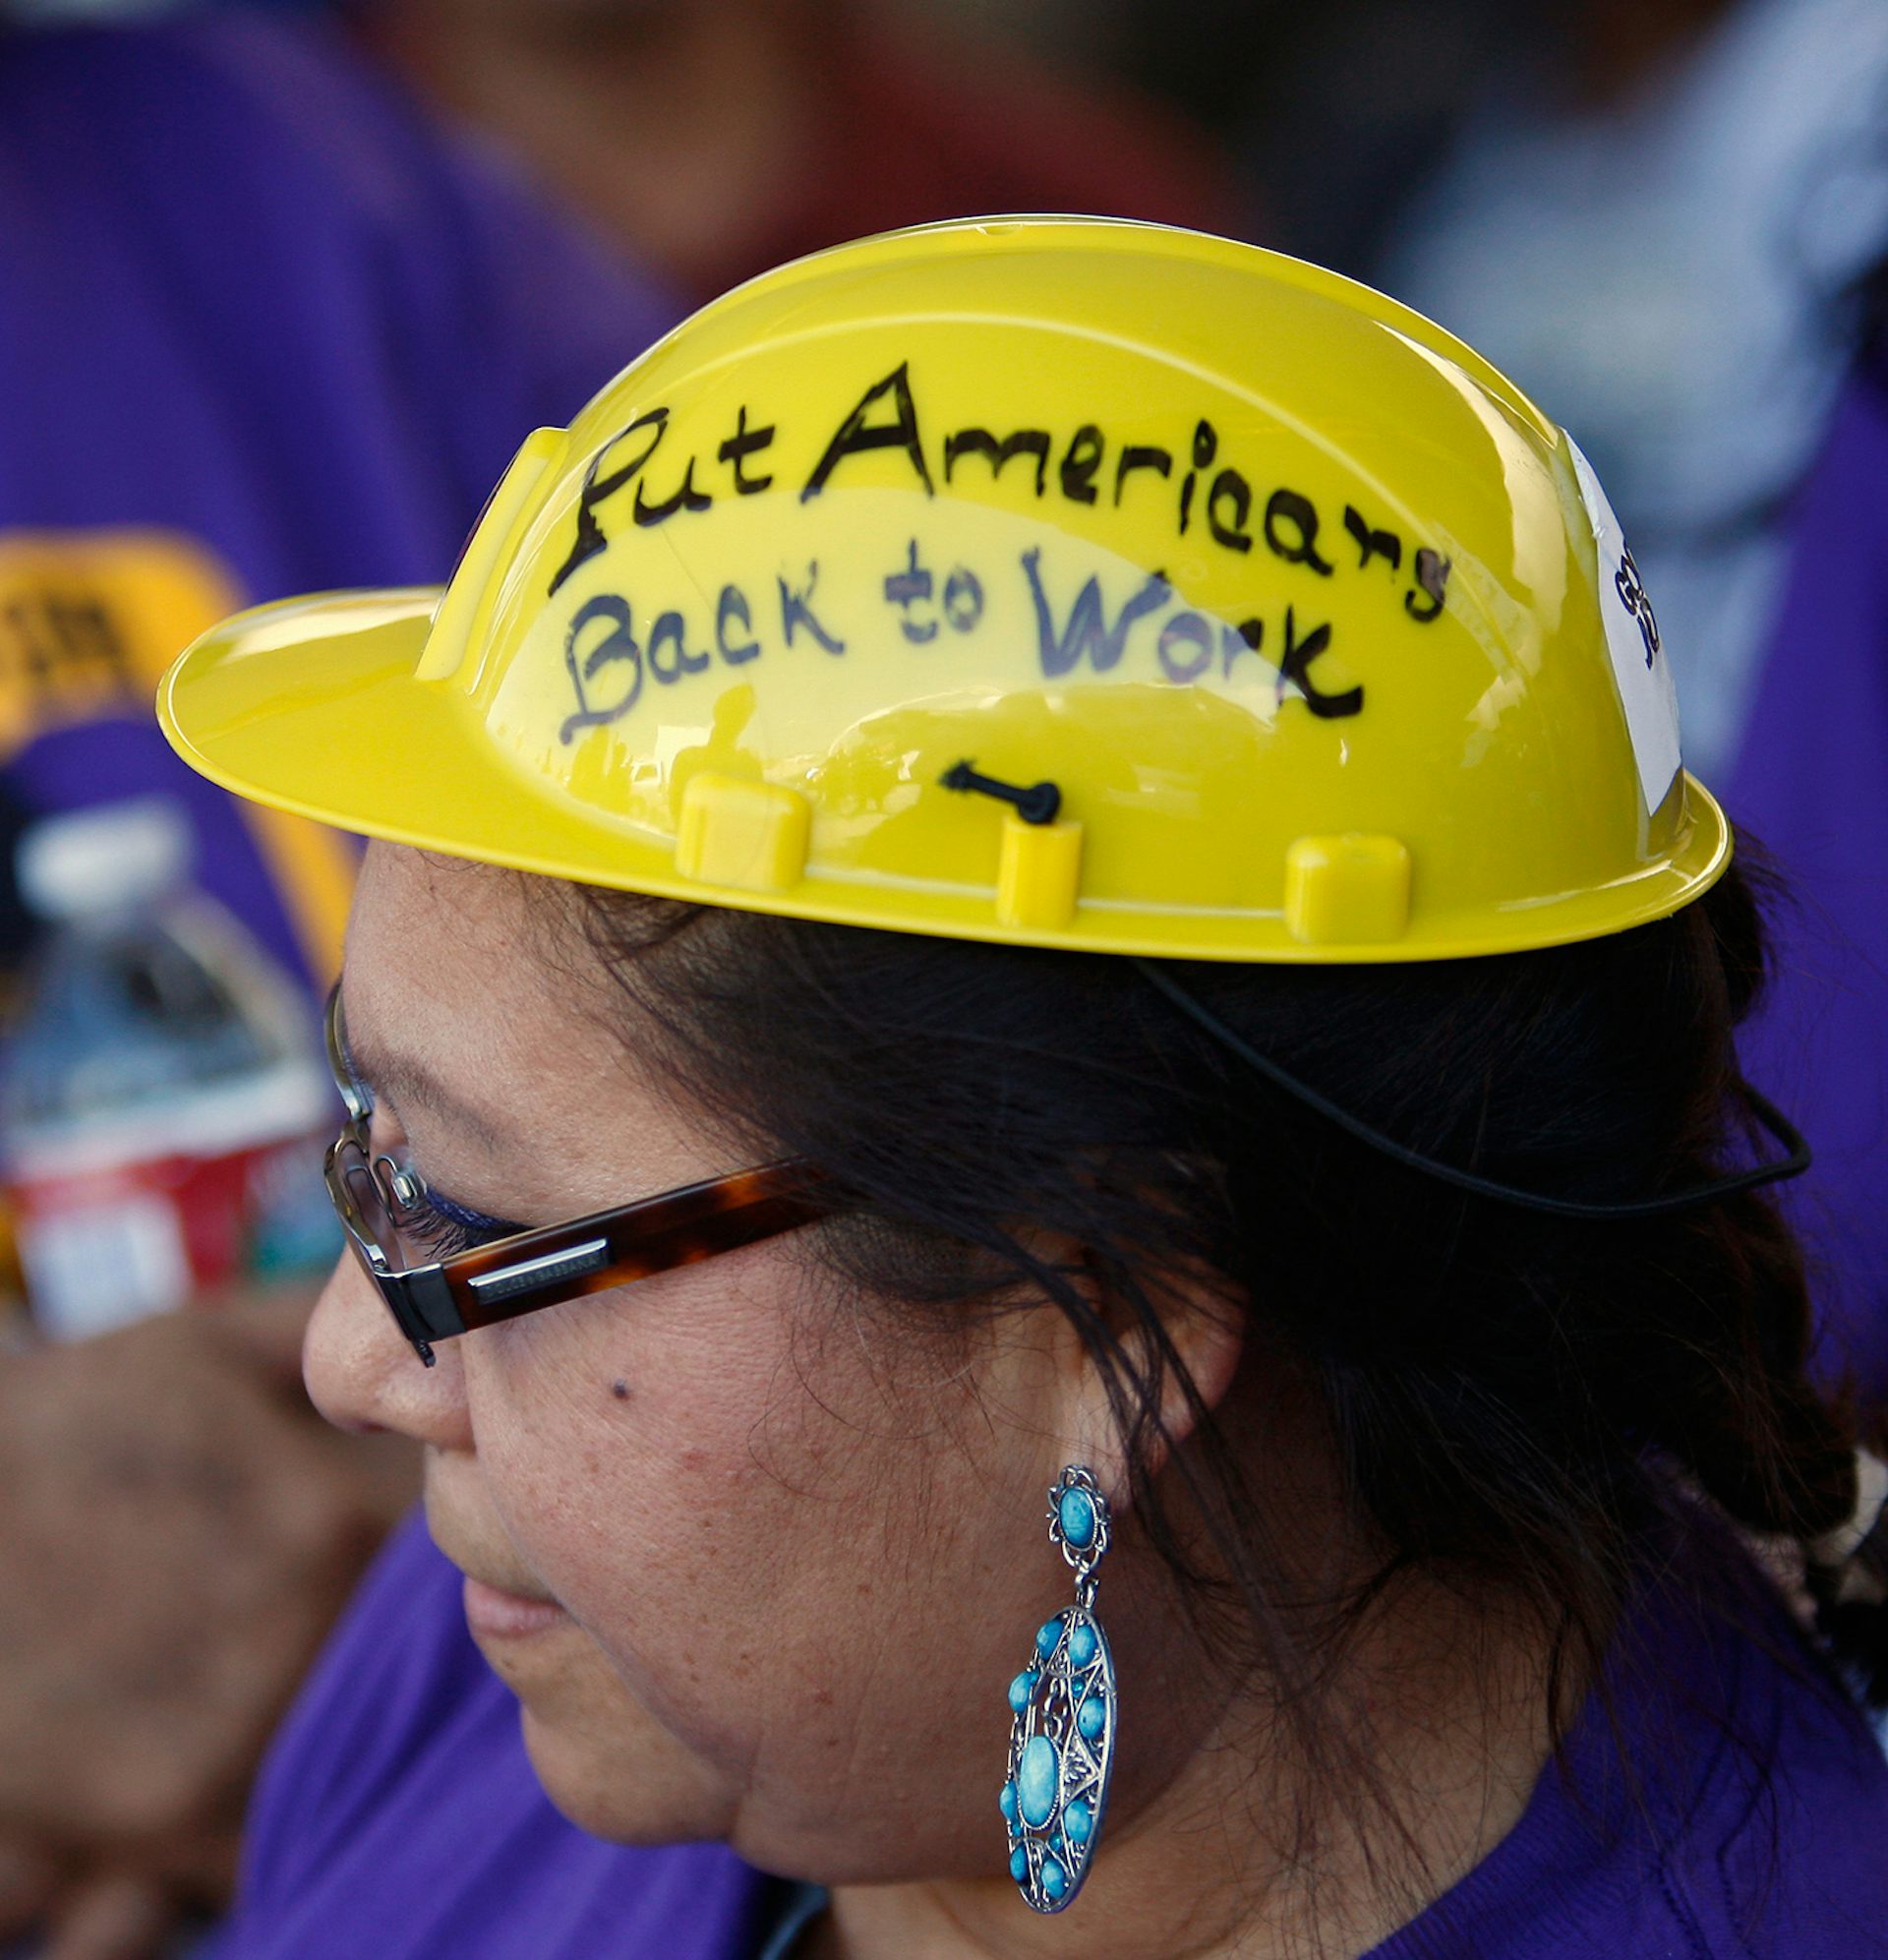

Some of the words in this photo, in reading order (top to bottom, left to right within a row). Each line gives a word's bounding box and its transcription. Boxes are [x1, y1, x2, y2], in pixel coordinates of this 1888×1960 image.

[548, 404, 776, 598] Put
[799, 360, 1452, 624] Americans
[883, 537, 984, 643] to
[1615, 541, 1644, 616] GO
[1636, 598, 1660, 671] JO
